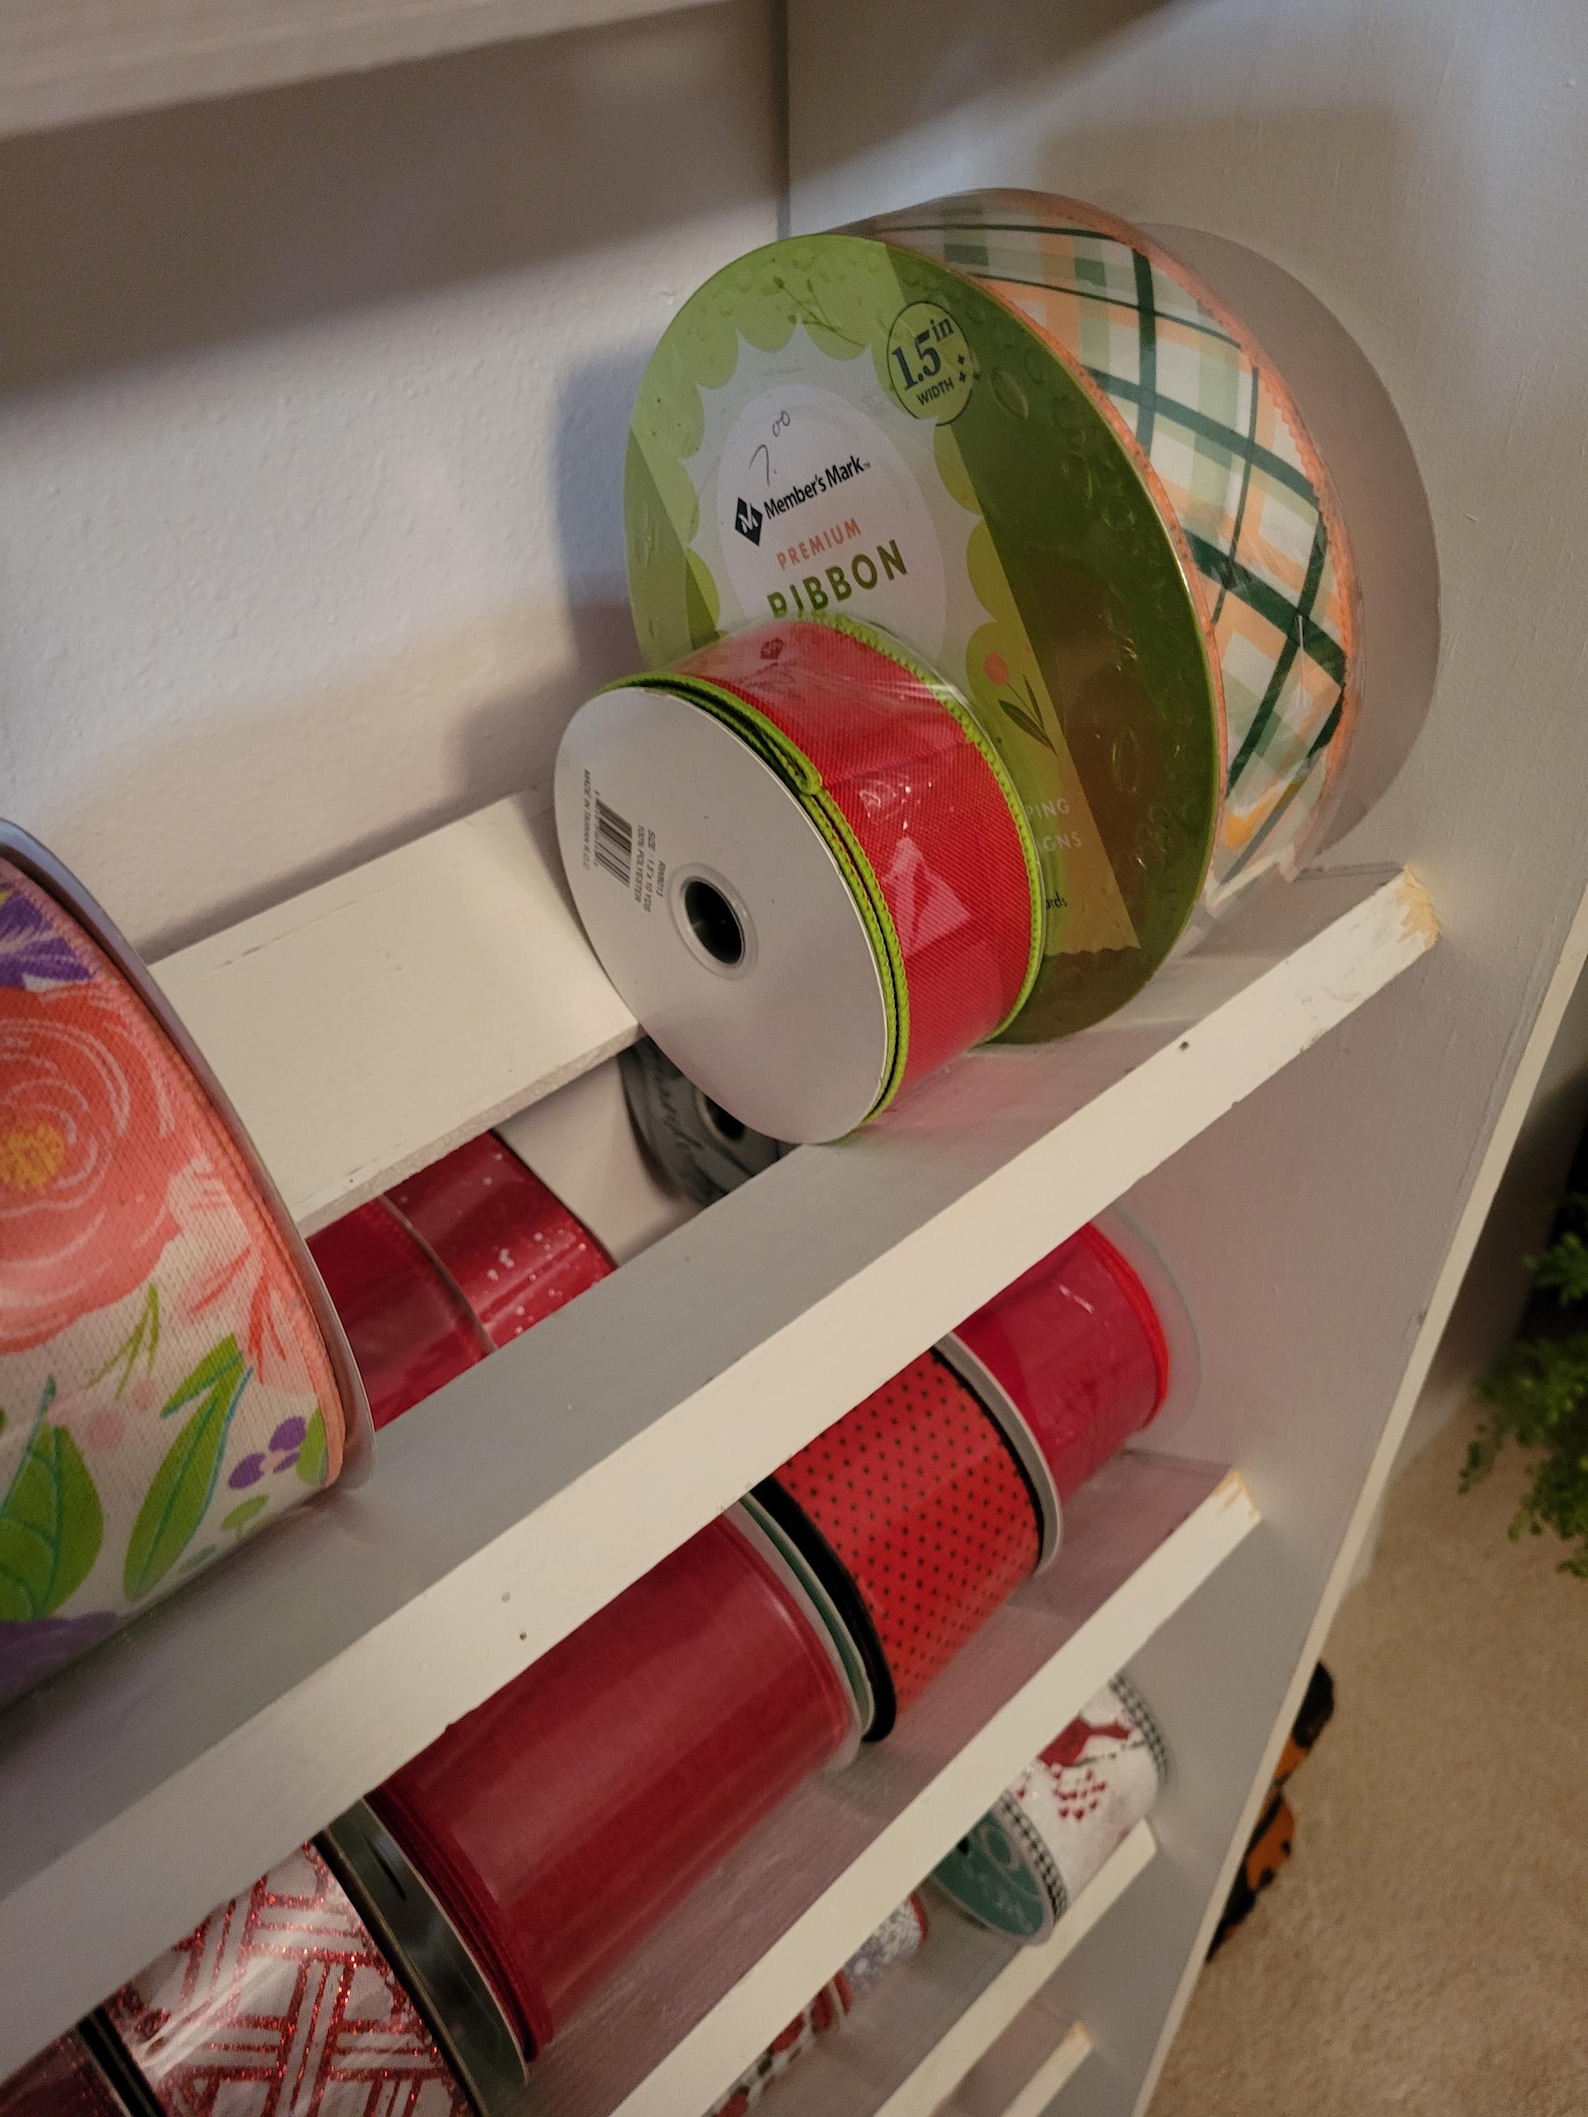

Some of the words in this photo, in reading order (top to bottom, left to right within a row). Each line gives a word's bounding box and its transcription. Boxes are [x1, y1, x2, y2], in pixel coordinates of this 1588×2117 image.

[916, 377, 955, 406] WIDTH
[764, 474, 826, 520] Member's
[776, 517, 862, 570] PREMIUM
[766, 539, 908, 618] RIBBON
[634, 848, 645, 902] POLYESTER
